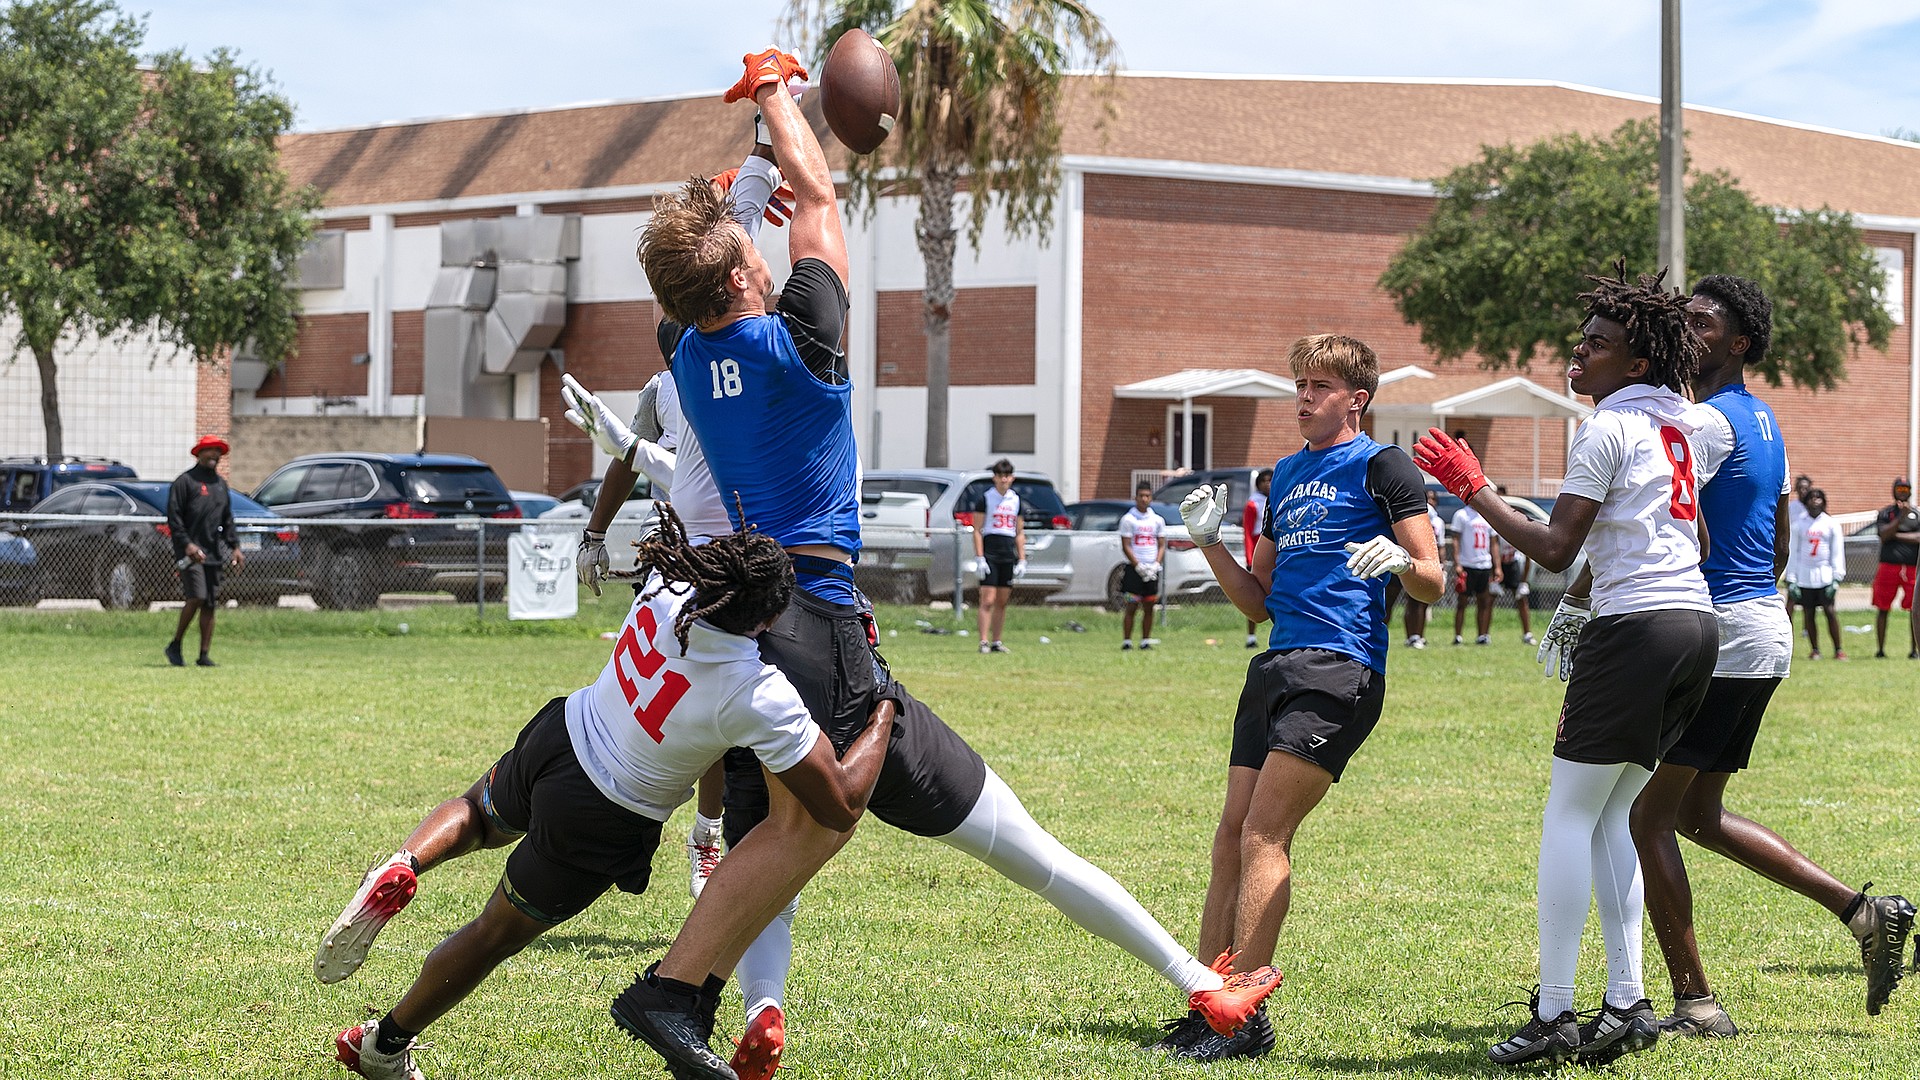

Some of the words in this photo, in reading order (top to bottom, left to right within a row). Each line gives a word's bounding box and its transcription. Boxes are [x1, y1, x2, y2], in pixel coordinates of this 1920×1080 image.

[710, 358, 743, 399] 18
[1754, 411, 1774, 441] 17
[1660, 425, 1696, 522] 8
[1278, 530, 1320, 552] PIRATES
[1809, 538, 1820, 557] 7
[521, 557, 572, 572] FIELD
[536, 579, 557, 596] #3
[614, 604, 692, 745] 21
